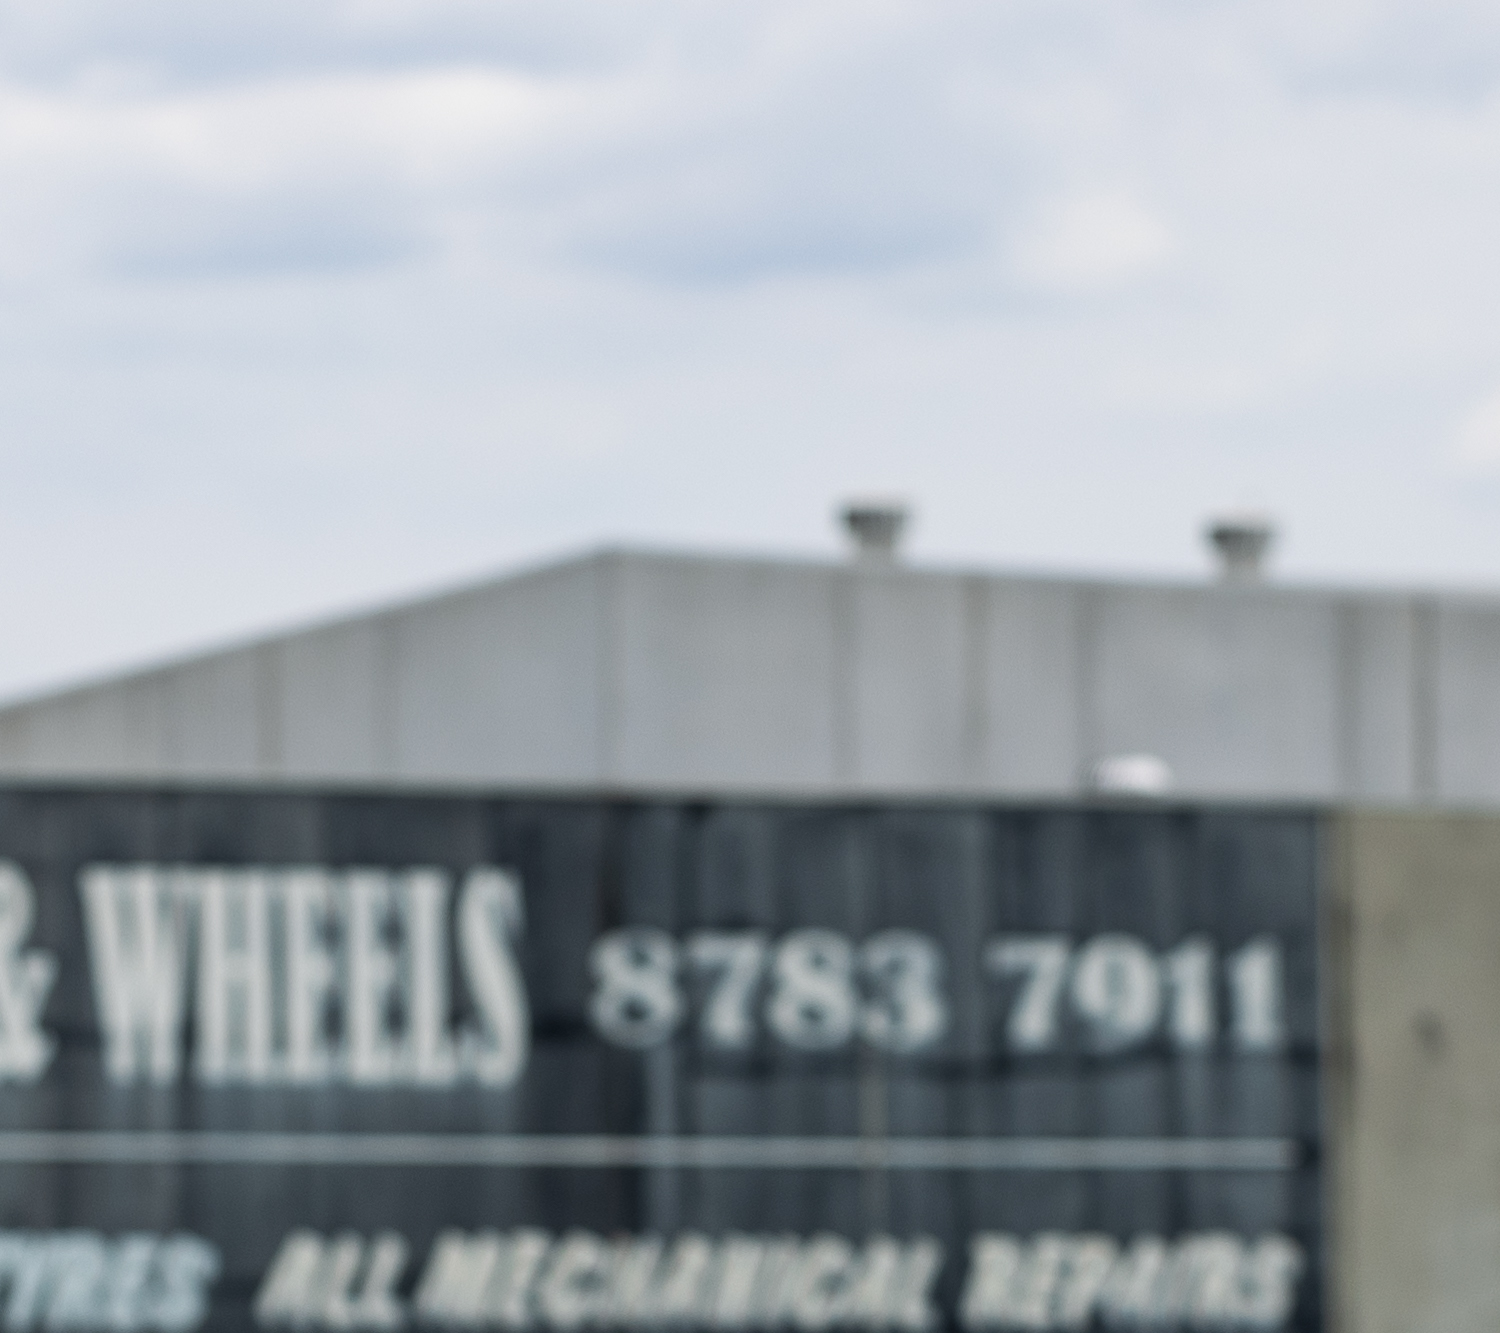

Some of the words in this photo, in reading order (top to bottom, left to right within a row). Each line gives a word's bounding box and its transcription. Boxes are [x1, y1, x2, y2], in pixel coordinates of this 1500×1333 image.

[80, 864, 530, 1090] WHEELS
[588, 926, 948, 1053] 8783
[984, 932, 1286, 1054] 7911
[253, 1228, 406, 1333] ALL
[410, 1228, 948, 1333] MECHANICAL
